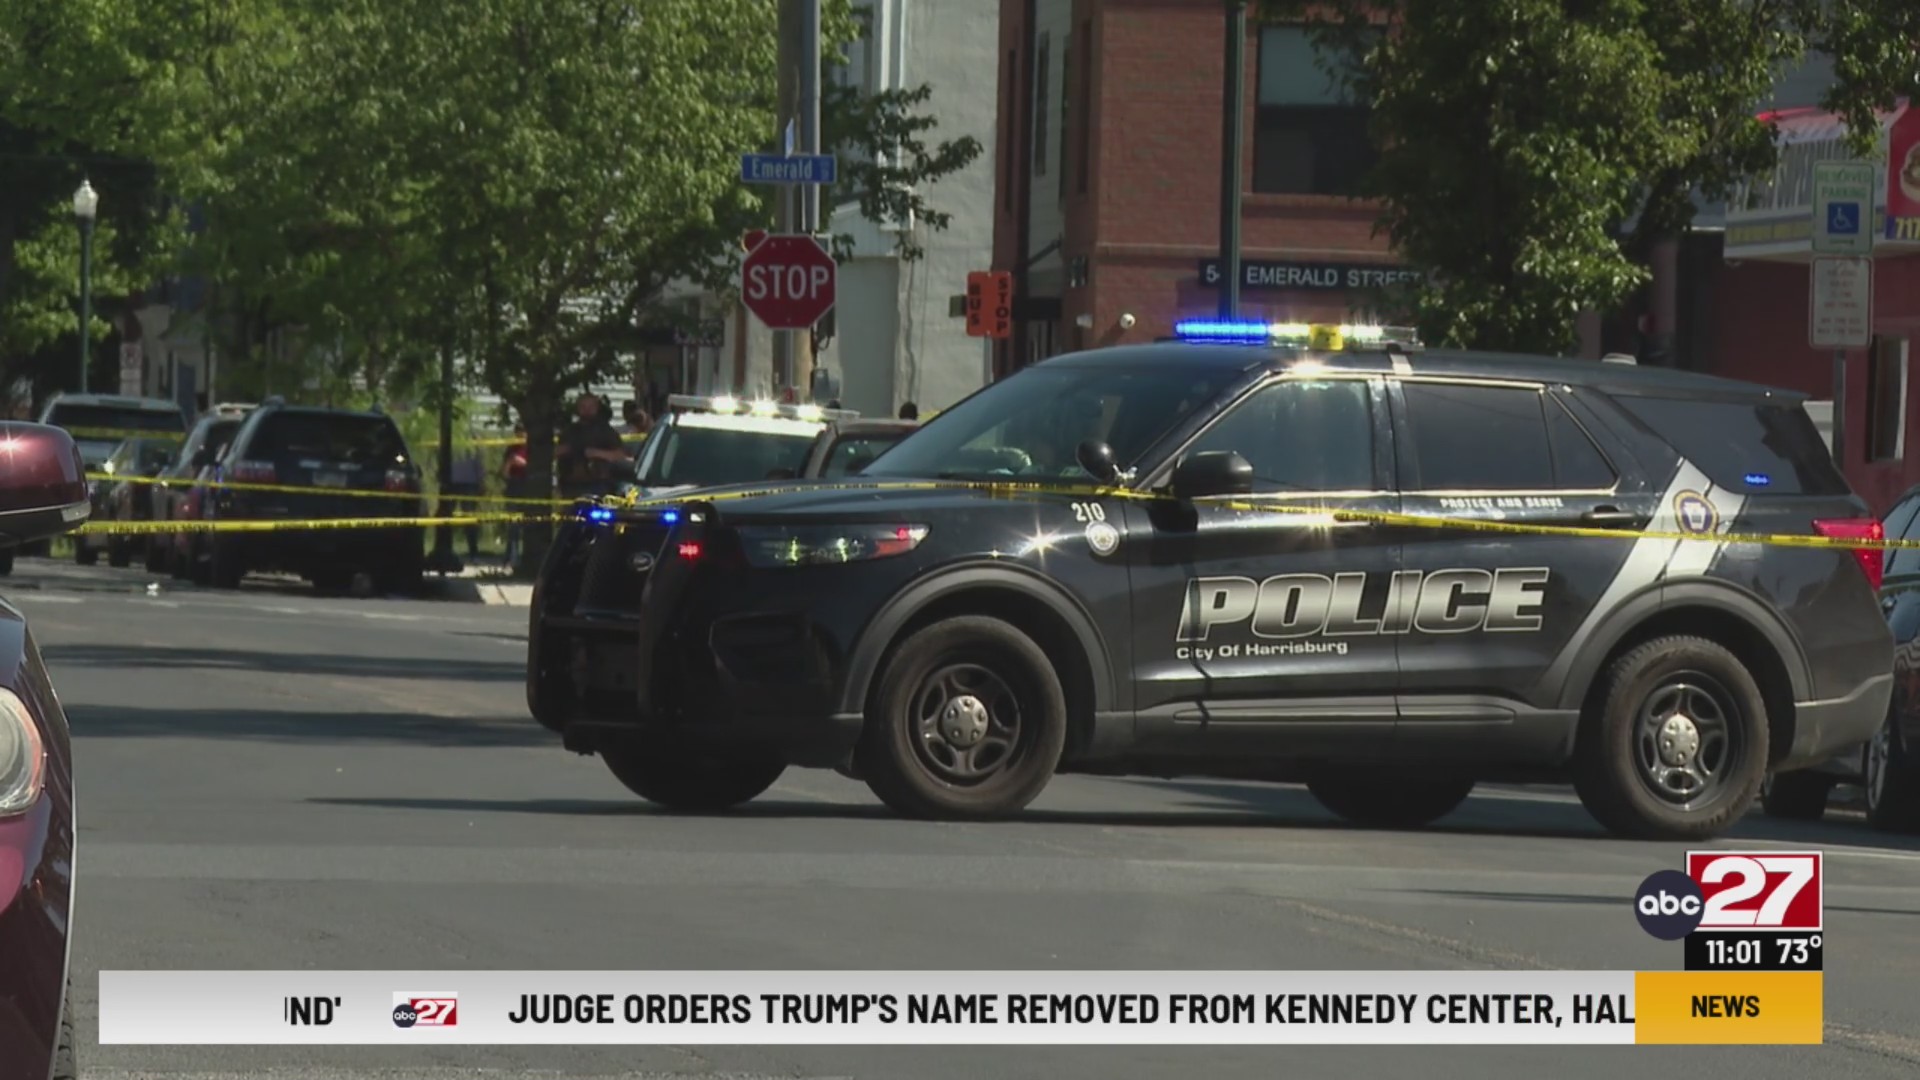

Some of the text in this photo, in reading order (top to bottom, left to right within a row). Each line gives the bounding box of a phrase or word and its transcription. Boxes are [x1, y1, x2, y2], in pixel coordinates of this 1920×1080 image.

[751, 157, 813, 180] Emerald
[1821, 186, 1867, 199] PARKING
[748, 264, 830, 300] STOP
[1246, 266, 1339, 287] EMERALD
[995, 277, 1009, 333] STOP
[1070, 501, 1106, 523] 210
[1439, 496, 1564, 509] PROTECT AND SERVE
[1175, 566, 1551, 643] POLICE
[1176, 642, 1349, 660] City Of Harrisburg
